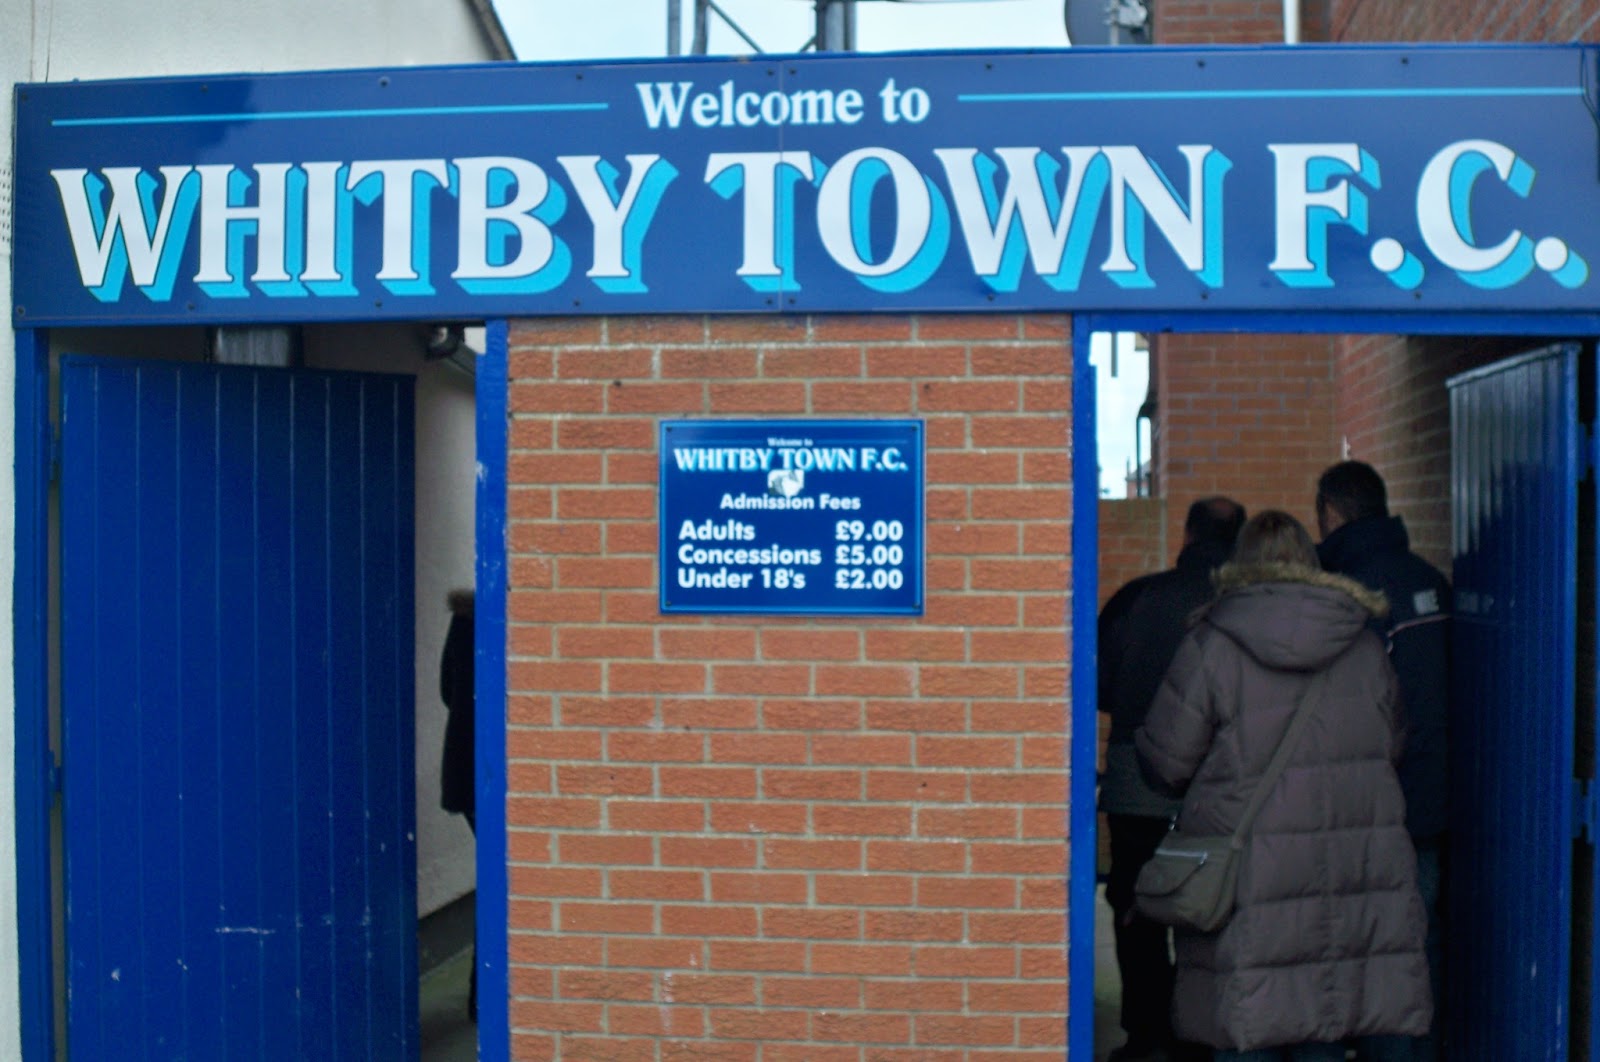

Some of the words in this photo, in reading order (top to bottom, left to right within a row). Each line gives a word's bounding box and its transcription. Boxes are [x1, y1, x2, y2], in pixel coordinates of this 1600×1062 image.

[635, 81, 865, 130] Welcome
[880, 77, 931, 124] to
[50, 153, 679, 302] WHITBY
[704, 144, 1233, 293] TOWN
[1268, 139, 1588, 289] F.C.
[767, 437, 802, 447] Welcome
[804, 437, 813, 447] to
[674, 447, 774, 472] WHITBY
[778, 448, 857, 472] TOWN
[860, 448, 909, 472] F.C.
[720, 493, 814, 510] Admission
[819, 494, 861, 510] Fees
[678, 519, 756, 541] Adults
[835, 520, 904, 541] £9.00
[677, 544, 822, 565] Concessions
[835, 544, 904, 566] £5.00
[677, 567, 753, 589] Under
[760, 568, 806, 590] 18's
[835, 569, 904, 590] £2.00
